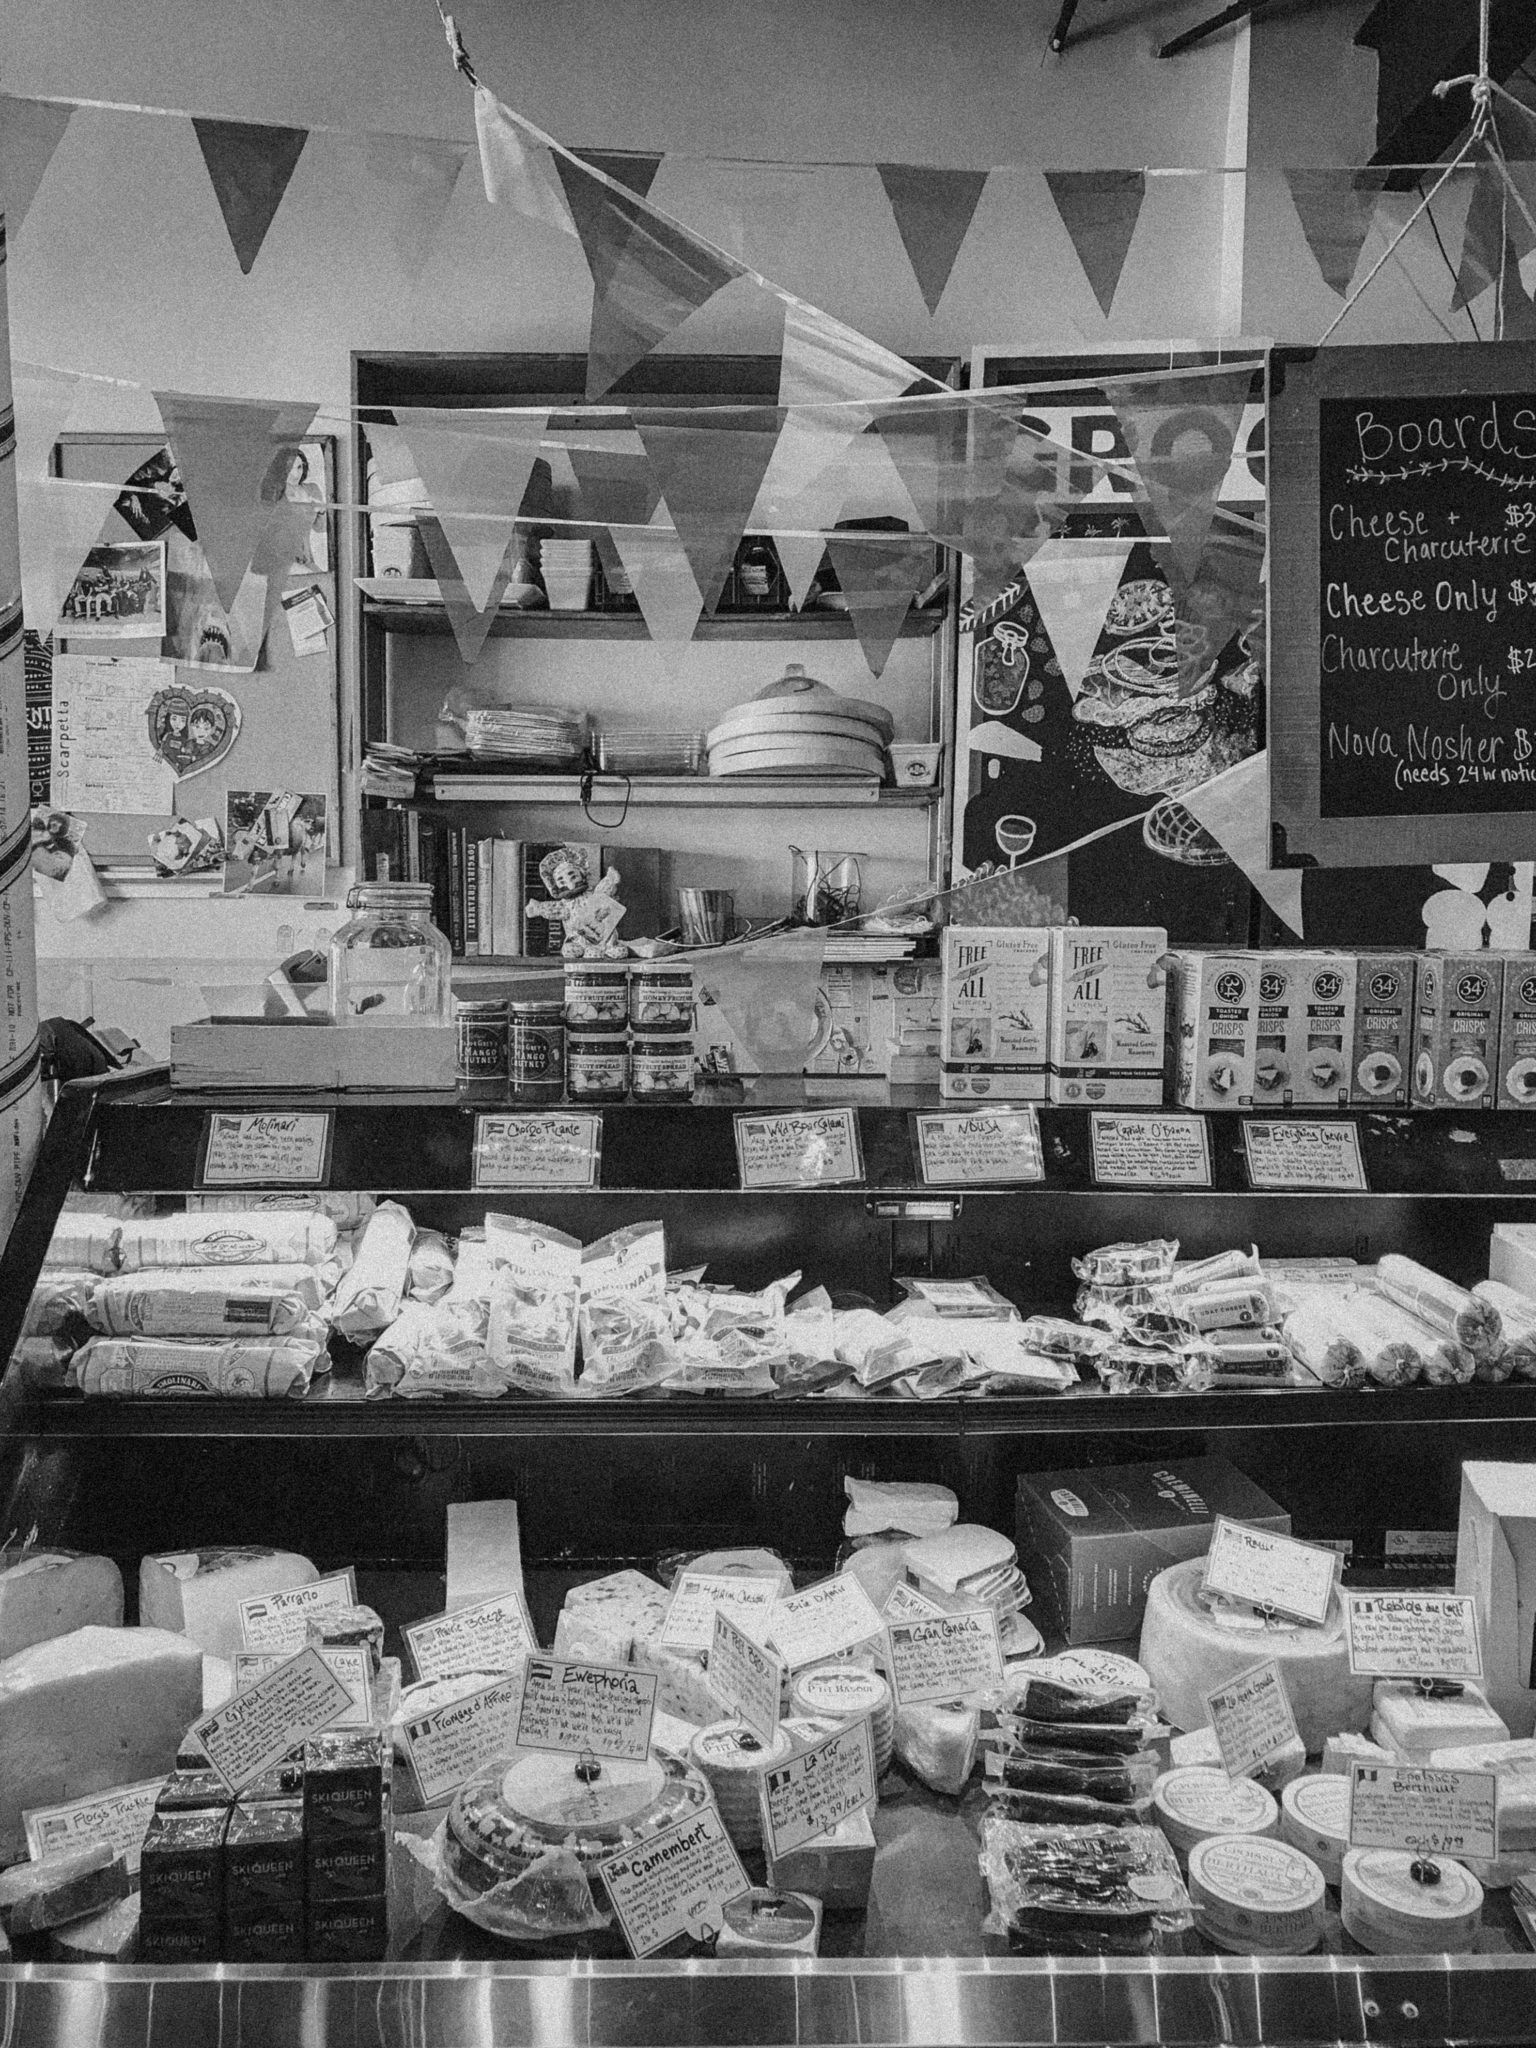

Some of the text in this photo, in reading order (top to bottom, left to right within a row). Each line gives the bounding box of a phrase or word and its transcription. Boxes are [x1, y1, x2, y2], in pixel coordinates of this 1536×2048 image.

[1356, 401, 1536, 461] Boards
[1329, 501, 1536, 540] Cheese + $3
[1384, 529, 1531, 562] Charcuterie
[1326, 581, 1426, 618] Cheese
[1436, 578, 1498, 622] Only
[1321, 633, 1462, 672] Charcuterie
[1437, 664, 1507, 719] Only
[56, 700, 77, 778] Scarpetta
[1328, 722, 1398, 759] Nova
[1407, 723, 1504, 763] Nosher
[1395, 759, 1450, 790] (needs
[1457, 765, 1479, 784] 24
[1482, 765, 1496, 781] hr
[467, 843, 476, 882] COWGIRL
[958, 946, 987, 968] FREE
[1074, 946, 1103, 969] FREE
[958, 977, 987, 998] ALL
[1073, 978, 1102, 1000] ALL
[1212, 1022, 1244, 1035] CRISPS
[1310, 1019, 1341, 1032] CRISPS
[1366, 1017, 1398, 1030] CRISPS
[1453, 1019, 1486, 1034] CRISPS
[464, 1047, 498, 1056] MANGO
[515, 1051, 545, 1060] MANGO
[247, 1117, 299, 1136] Molinari
[766, 1120, 789, 1137] Wild
[1153, 1470, 1209, 1514] CREMINELLI
[270, 1584, 319, 1612] Parrano
[784, 1598, 811, 1613] Brie
[434, 1606, 506, 1639] Prairie Breeze
[561, 1664, 642, 1699] Ewephoria
[803, 1736, 841, 1772] La Tur
[312, 1787, 373, 1804] SKI QUEEN
[72, 1805, 110, 1831] Flory's
[315, 1853, 375, 1868] SKI QUEEN
[627, 1818, 712, 1881] Camembert
[149, 1869, 211, 1885] SKI QUEEN
[232, 1860, 293, 1876] SKI QUEEN
[253, 1922, 294, 1936] QUEEN
[315, 1917, 374, 1932] SKI QUEEN
